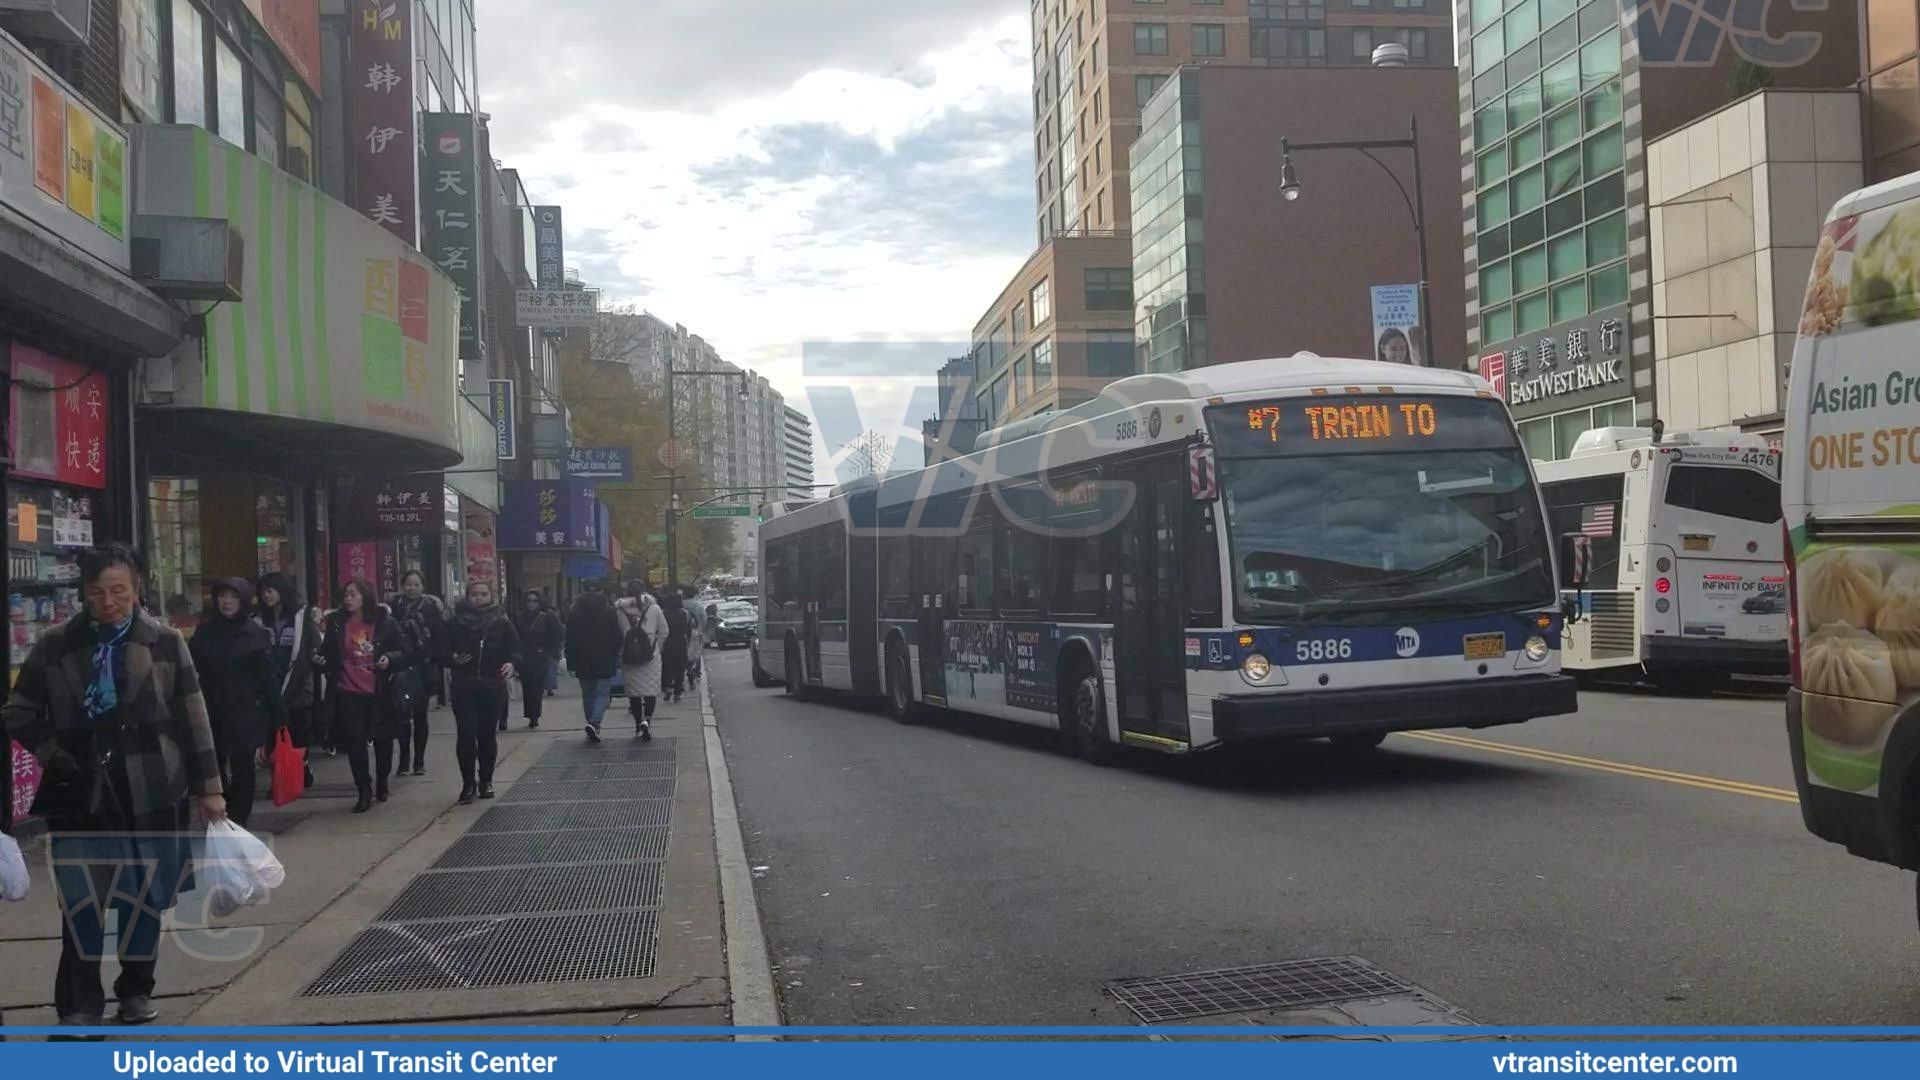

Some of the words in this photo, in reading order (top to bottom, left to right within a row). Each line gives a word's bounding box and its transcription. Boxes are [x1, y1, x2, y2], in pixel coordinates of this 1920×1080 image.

[1510, 319, 1616, 376] 華美銀行
[1576, 359, 1619, 389] BANK
[1810, 376, 1877, 415] Asian
[1116, 419, 1137, 440] 5886
[1248, 407, 1280, 441] #7
[1305, 404, 1391, 440] TRAIN
[1400, 403, 1436, 436] TO
[1741, 453, 1774, 466] 4476
[1810, 432, 1864, 471] ONE
[1702, 581, 1740, 590] INFINITI
[1742, 582, 1755, 590] OF
[1296, 638, 1352, 660] 5886
[1395, 634, 1416, 651] MTA
